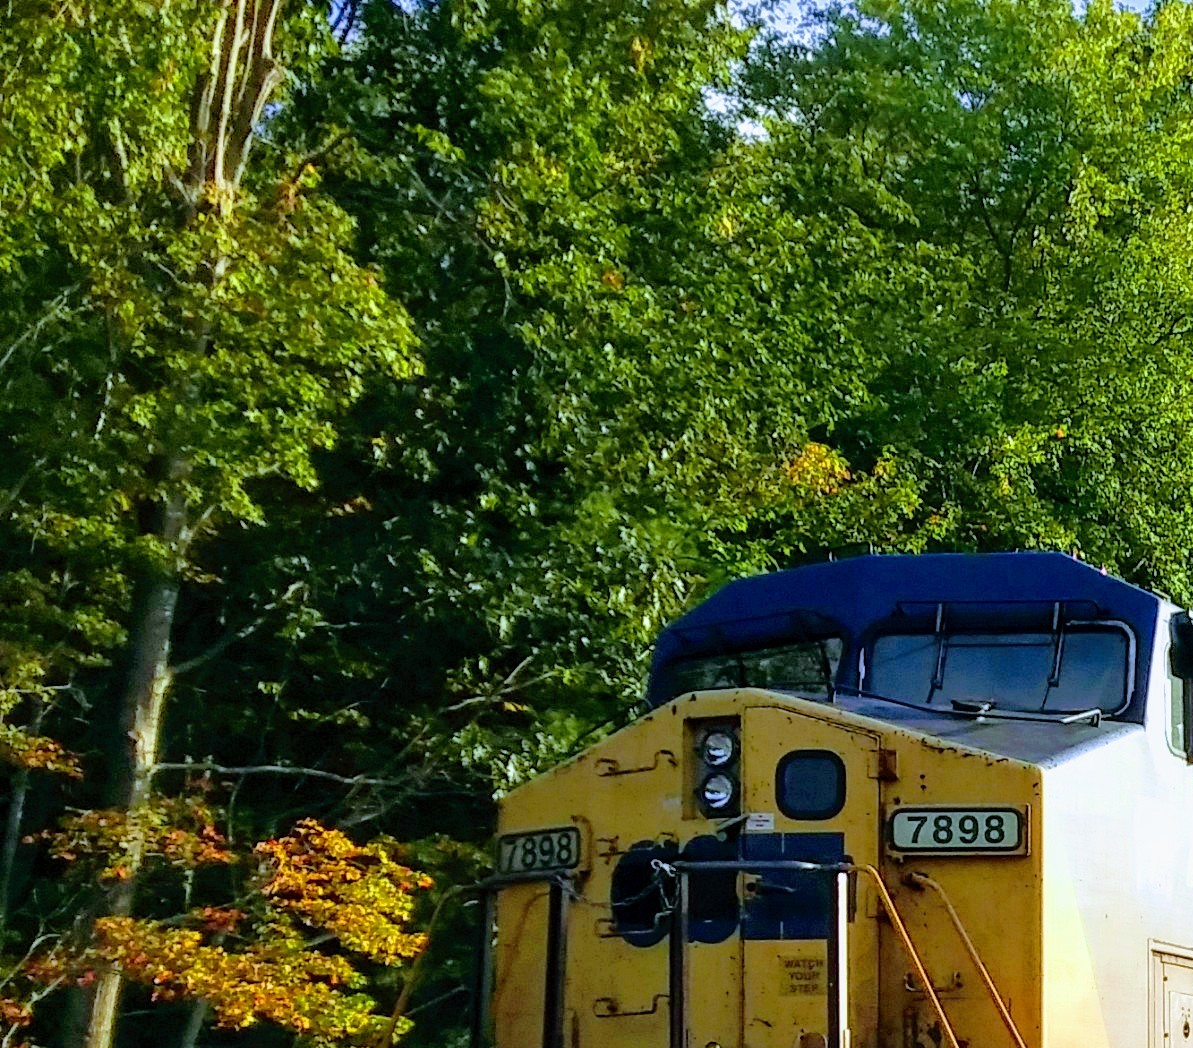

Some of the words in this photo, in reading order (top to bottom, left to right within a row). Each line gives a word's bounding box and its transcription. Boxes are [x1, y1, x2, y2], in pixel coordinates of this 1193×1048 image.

[907, 815, 1005, 844] 7898
[503, 833, 572, 873] 7898
[784, 959, 824, 970] WATCH
[789, 971, 821, 981] YOUR
[790, 984, 819, 993] STEP
